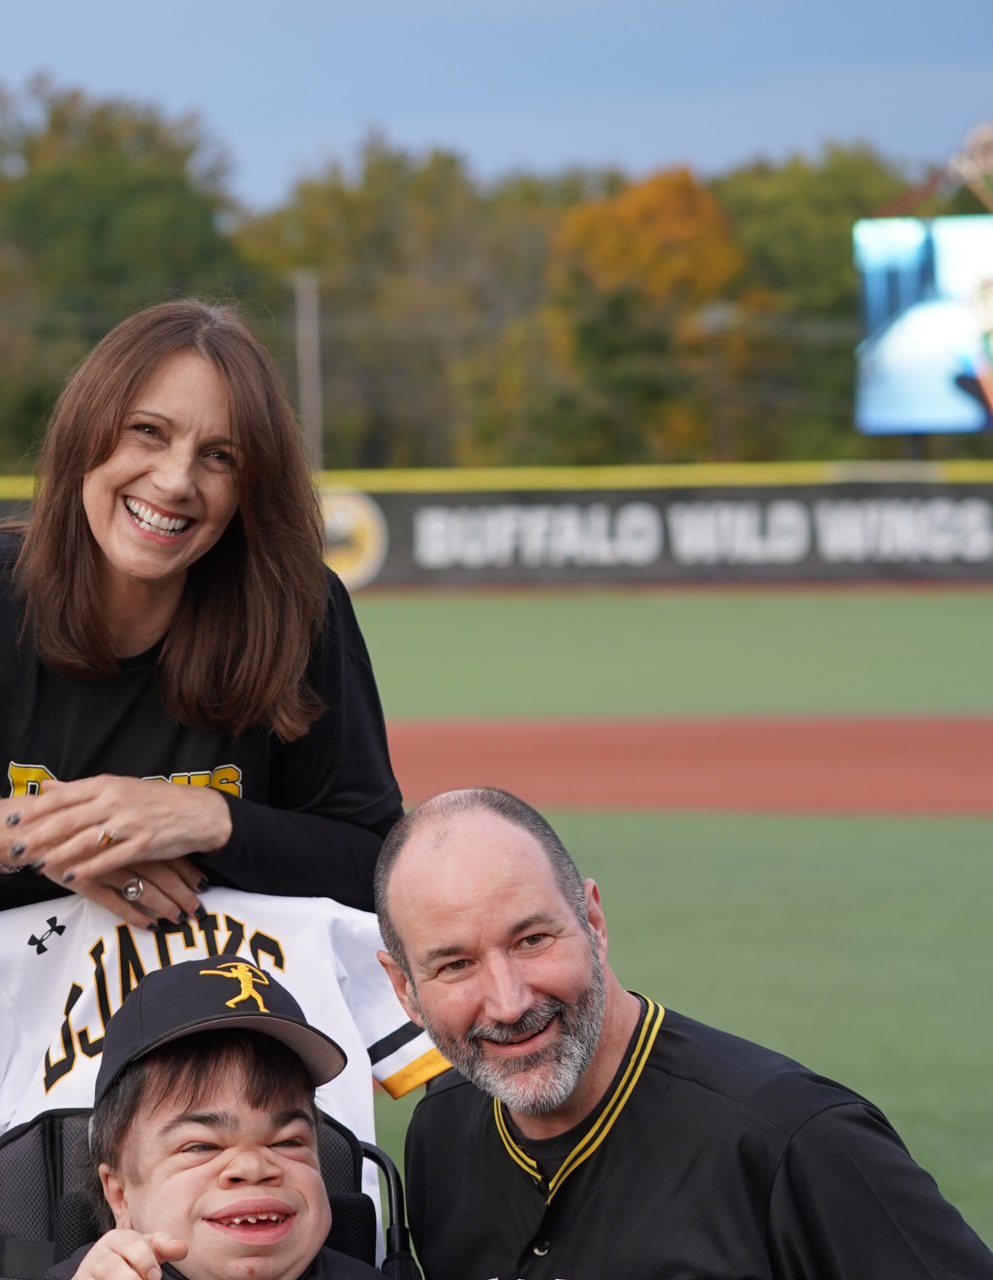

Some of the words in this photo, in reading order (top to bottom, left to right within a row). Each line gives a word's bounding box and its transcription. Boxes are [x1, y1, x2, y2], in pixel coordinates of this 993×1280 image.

[413, 506, 663, 568] BUFFALO
[668, 502, 811, 564] WILD
[814, 499, 992, 563] WINGS
